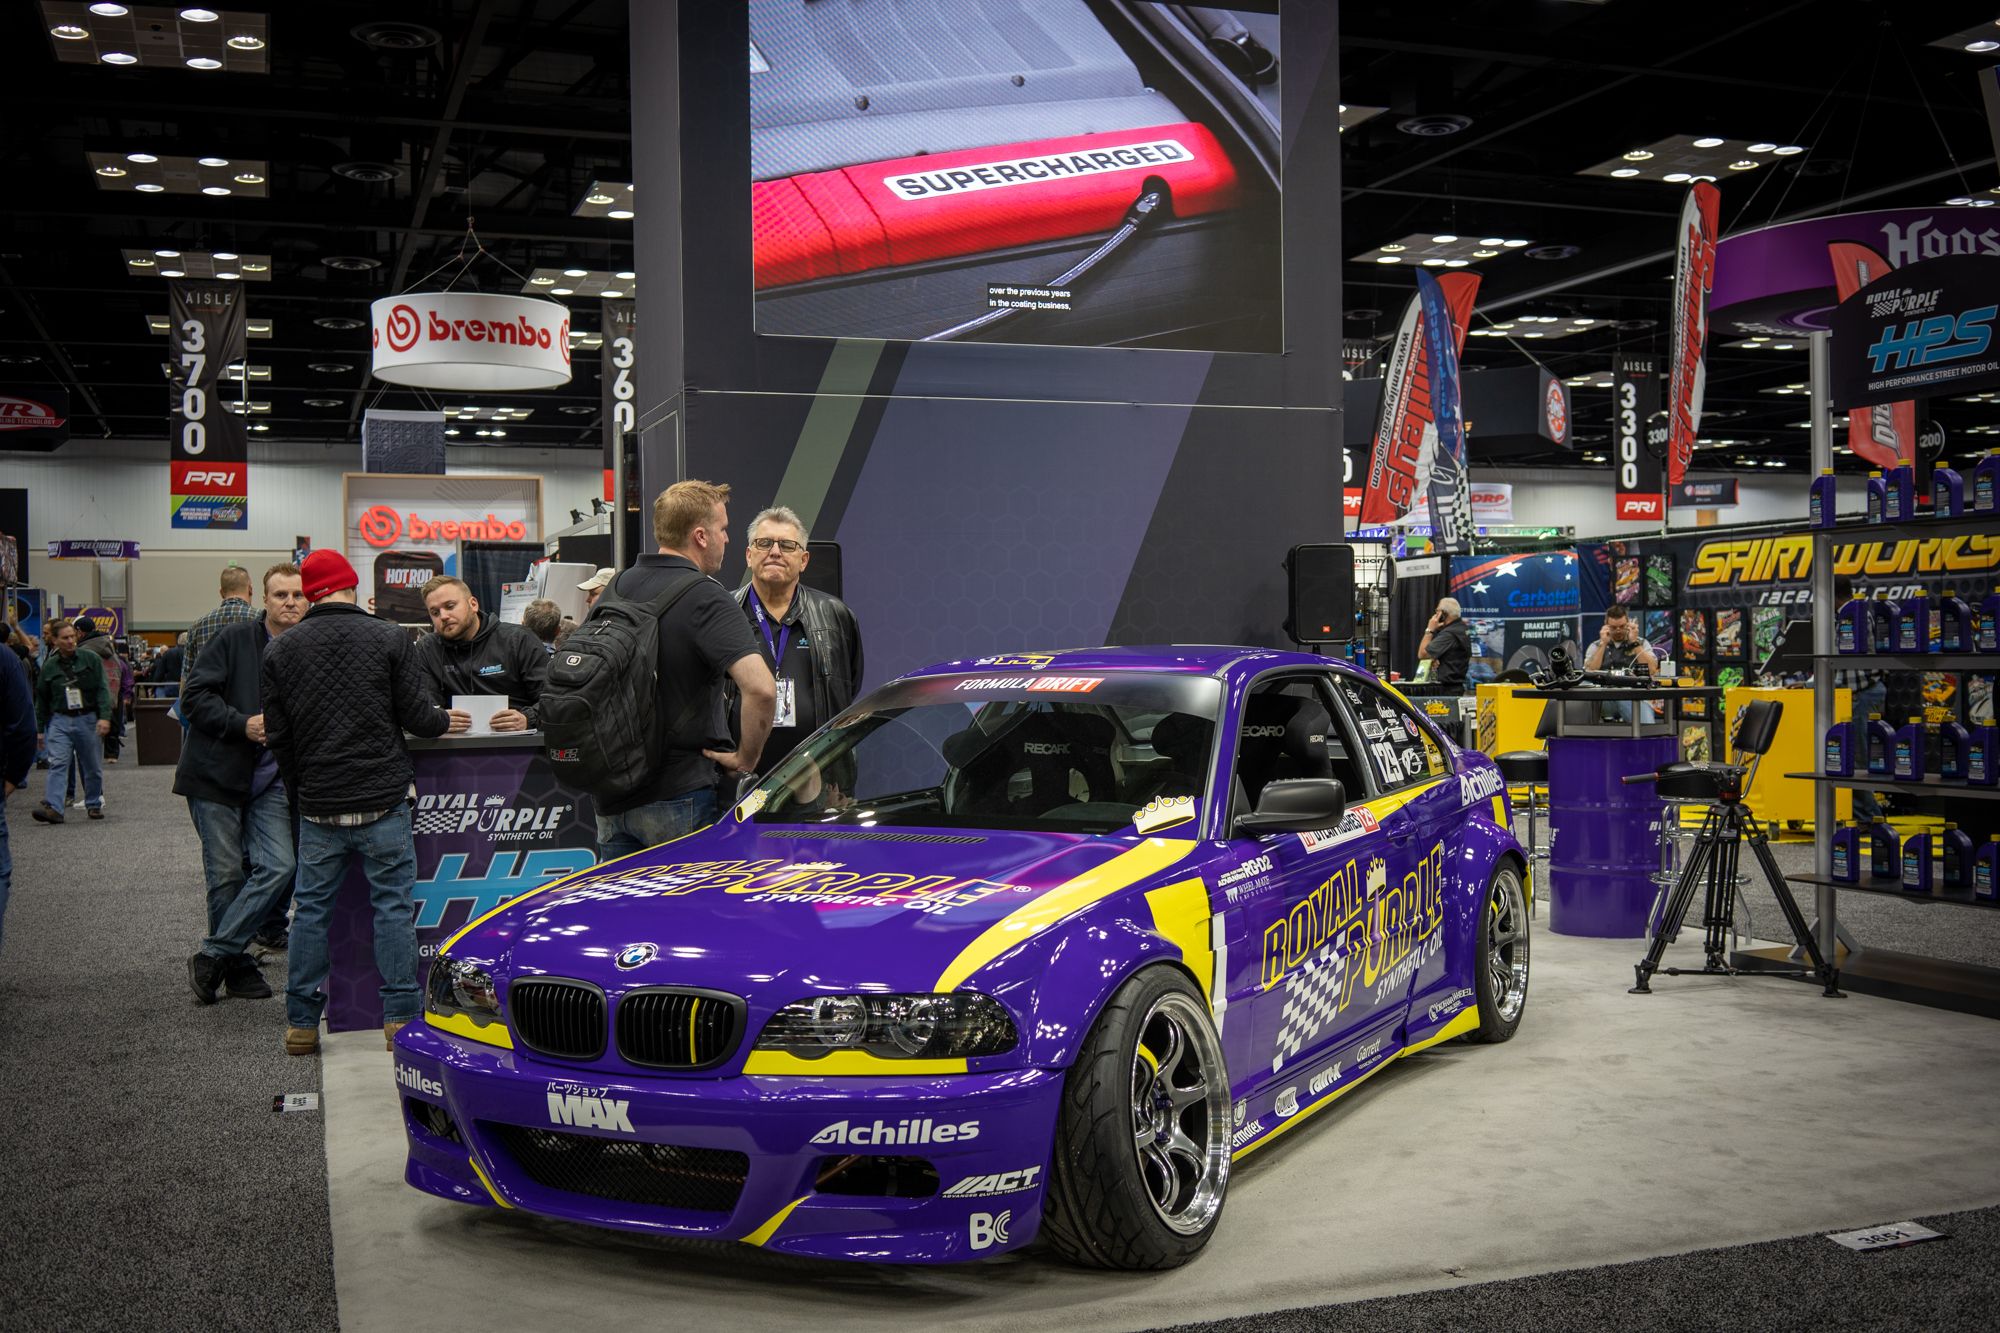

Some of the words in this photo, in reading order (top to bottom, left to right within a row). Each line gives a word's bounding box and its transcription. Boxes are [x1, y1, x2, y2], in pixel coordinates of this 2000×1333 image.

[896, 143, 1183, 196] SUPERCHARGED
[185, 292, 233, 305] AISLE
[989, 287, 1005, 295] over
[1006, 287, 1019, 296] the
[1019, 288, 1050, 298] previous
[1051, 289, 1071, 299] years
[989, 299, 997, 307] in
[998, 299, 1010, 308] the
[1010, 300, 1037, 311] coating
[1865, 288, 1901, 305] ROYAL
[1892, 290, 1940, 316] PURPLE
[428, 310, 552, 350] brembo
[1867, 304, 1999, 374] HPS
[1623, 361, 1653, 372] AISLE
[1868, 381, 1885, 391] HIGH
[1885, 373, 1935, 388] PERFORMANCE
[1934, 367, 1960, 380] STREET
[1960, 364, 1987, 375] MOTOR
[1987, 361, 1999, 371] OIL
[182, 319, 206, 455] 3700
[1620, 382, 1638, 490] 3300
[183, 471, 236, 486] PRI
[1624, 501, 1656, 513] PRI
[408, 513, 527, 541] brembo
[386, 568, 409, 584] HOT
[409, 568, 433, 584] ROD
[1507, 587, 1579, 607] Carbotech
[1521, 631, 1542, 639] FINISH
[1524, 622, 1544, 630] BRAKE
[953, 677, 1036, 691] FORMULA
[1033, 677, 1098, 691] DRIFT
[1241, 725, 1285, 737] ECARO
[1370, 741, 1405, 784] 129
[1459, 767, 1504, 807] Achilles
[457, 806, 565, 834] PURPLE
[487, 832, 535, 841] SYNTHETIC
[538, 831, 554, 840] OIL
[555, 858, 784, 893] ROYAL
[663, 872, 1013, 907] PURPLE
[743, 892, 899, 908] SYNTHETIC
[903, 899, 954, 915] OIL
[1261, 858, 1363, 992] ROYAL
[1338, 843, 1443, 1013] PURPLE
[1373, 945, 1427, 1005] SYNTHETIC
[1429, 924, 1443, 957] OIL
[1356, 1037, 1382, 1062] Garrett
[547, 1081, 608, 1098] パーツショップ
[547, 1092, 636, 1133] MAX
[808, 1118, 980, 1145] Achilles
[1232, 1118, 1265, 1148] ermatex
[979, 1190, 1003, 1198] CLUTCH
[1004, 1183, 1040, 1194] TECHNOLOGY
[969, 1209, 1012, 1251] BC
